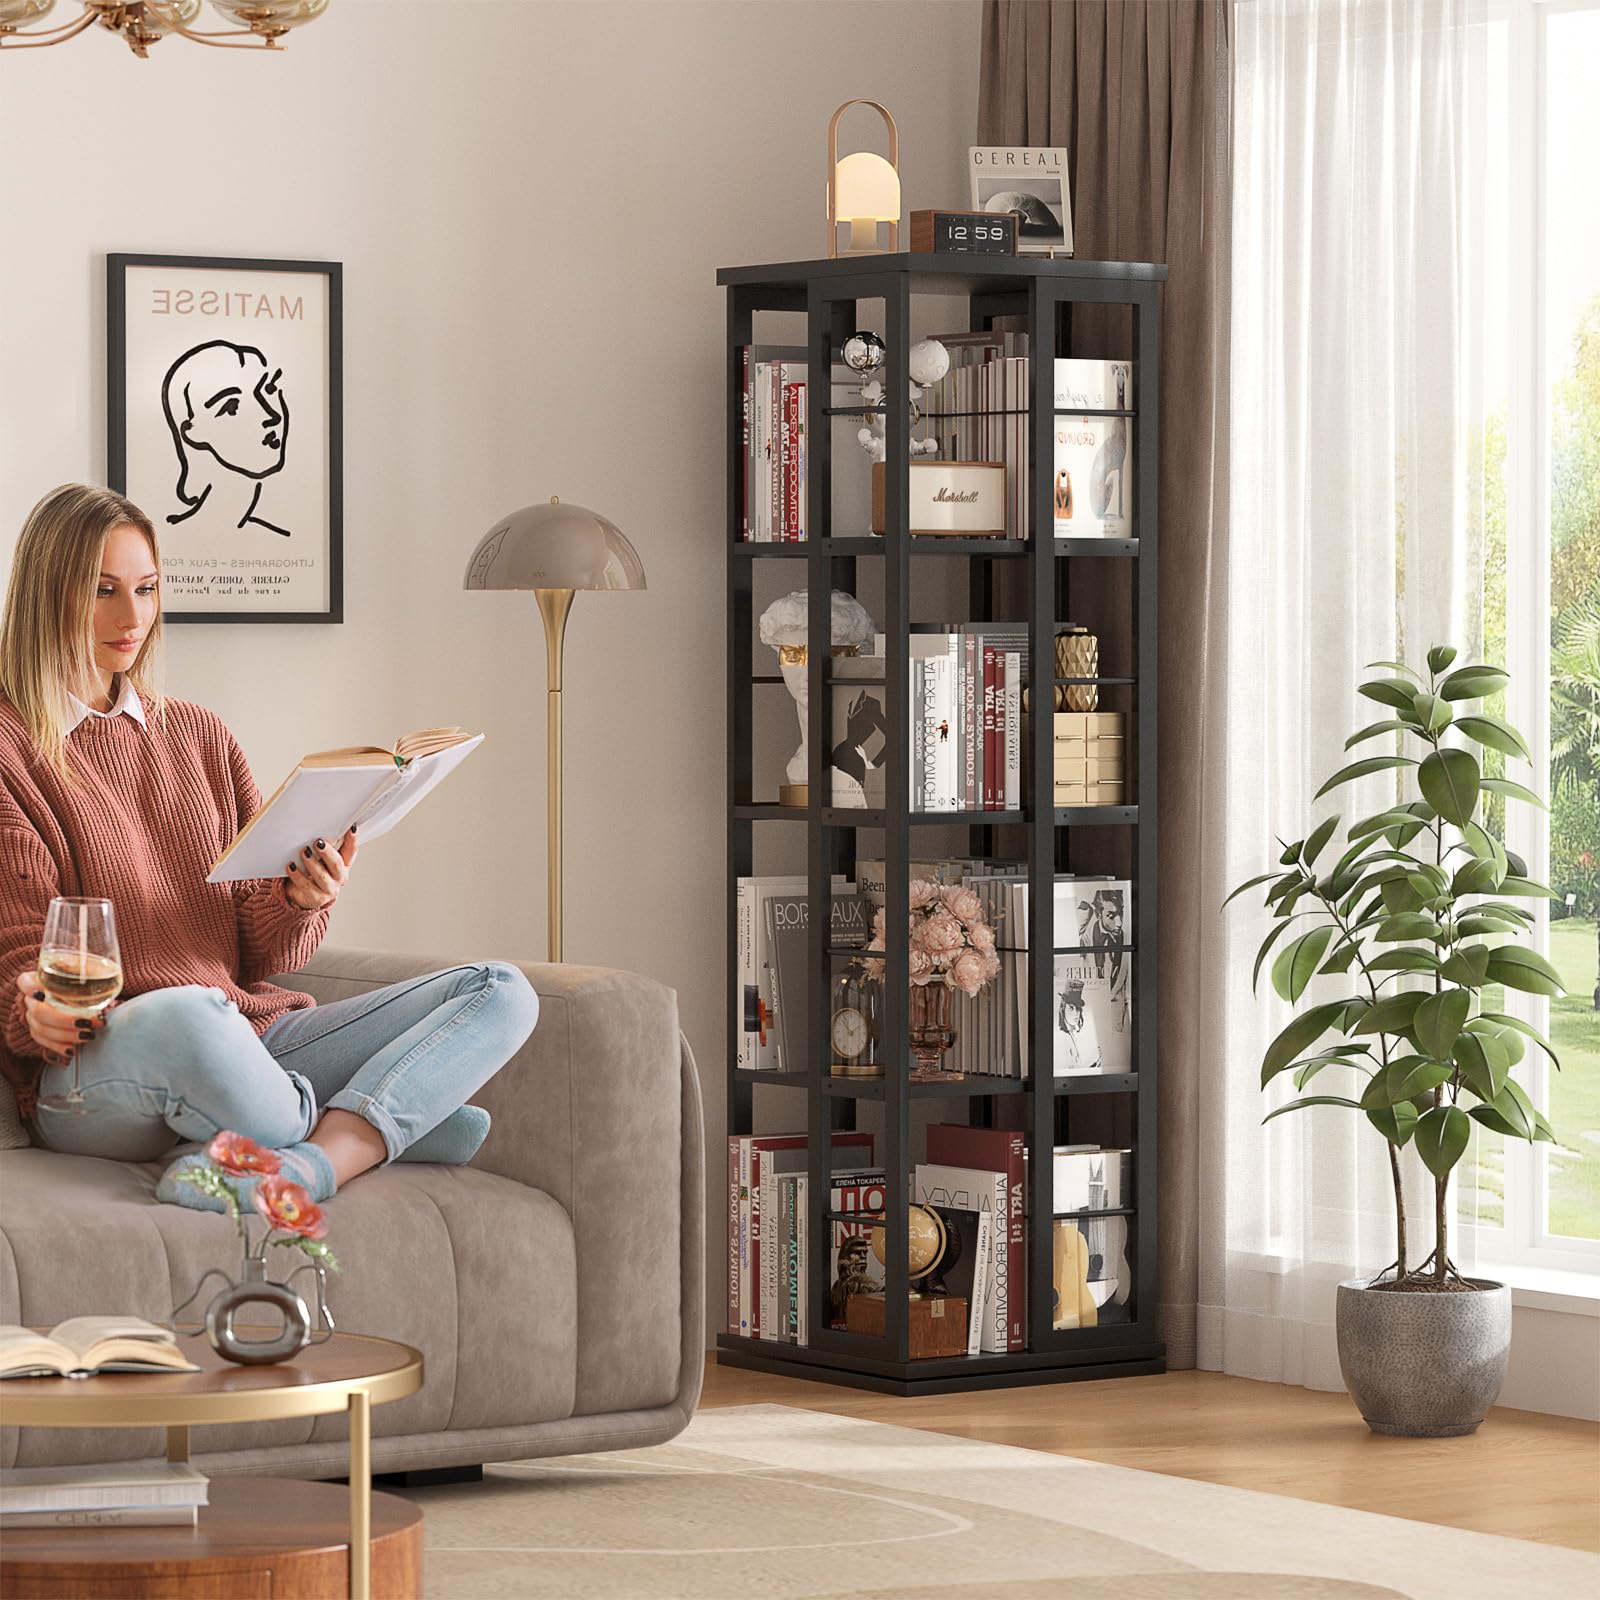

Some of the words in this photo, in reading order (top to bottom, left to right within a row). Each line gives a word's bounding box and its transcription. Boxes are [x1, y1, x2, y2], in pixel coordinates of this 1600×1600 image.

[974, 152, 1062, 166] CEREAL
[948, 226, 968, 240] 12
[976, 227, 1003, 241] 59
[932, 487, 980, 503] Marshall
[966, 676, 974, 711] BOOK
[966, 724, 974, 787] SYMBOLS
[862, 878, 885, 892] Been
[770, 968, 778, 1014] BORDEAUX
[836, 1179, 856, 1187] ЕЛЕНА
[857, 1178, 886, 1186] ТОКАРЕВ
[841, 1186, 886, 1216] ПО
